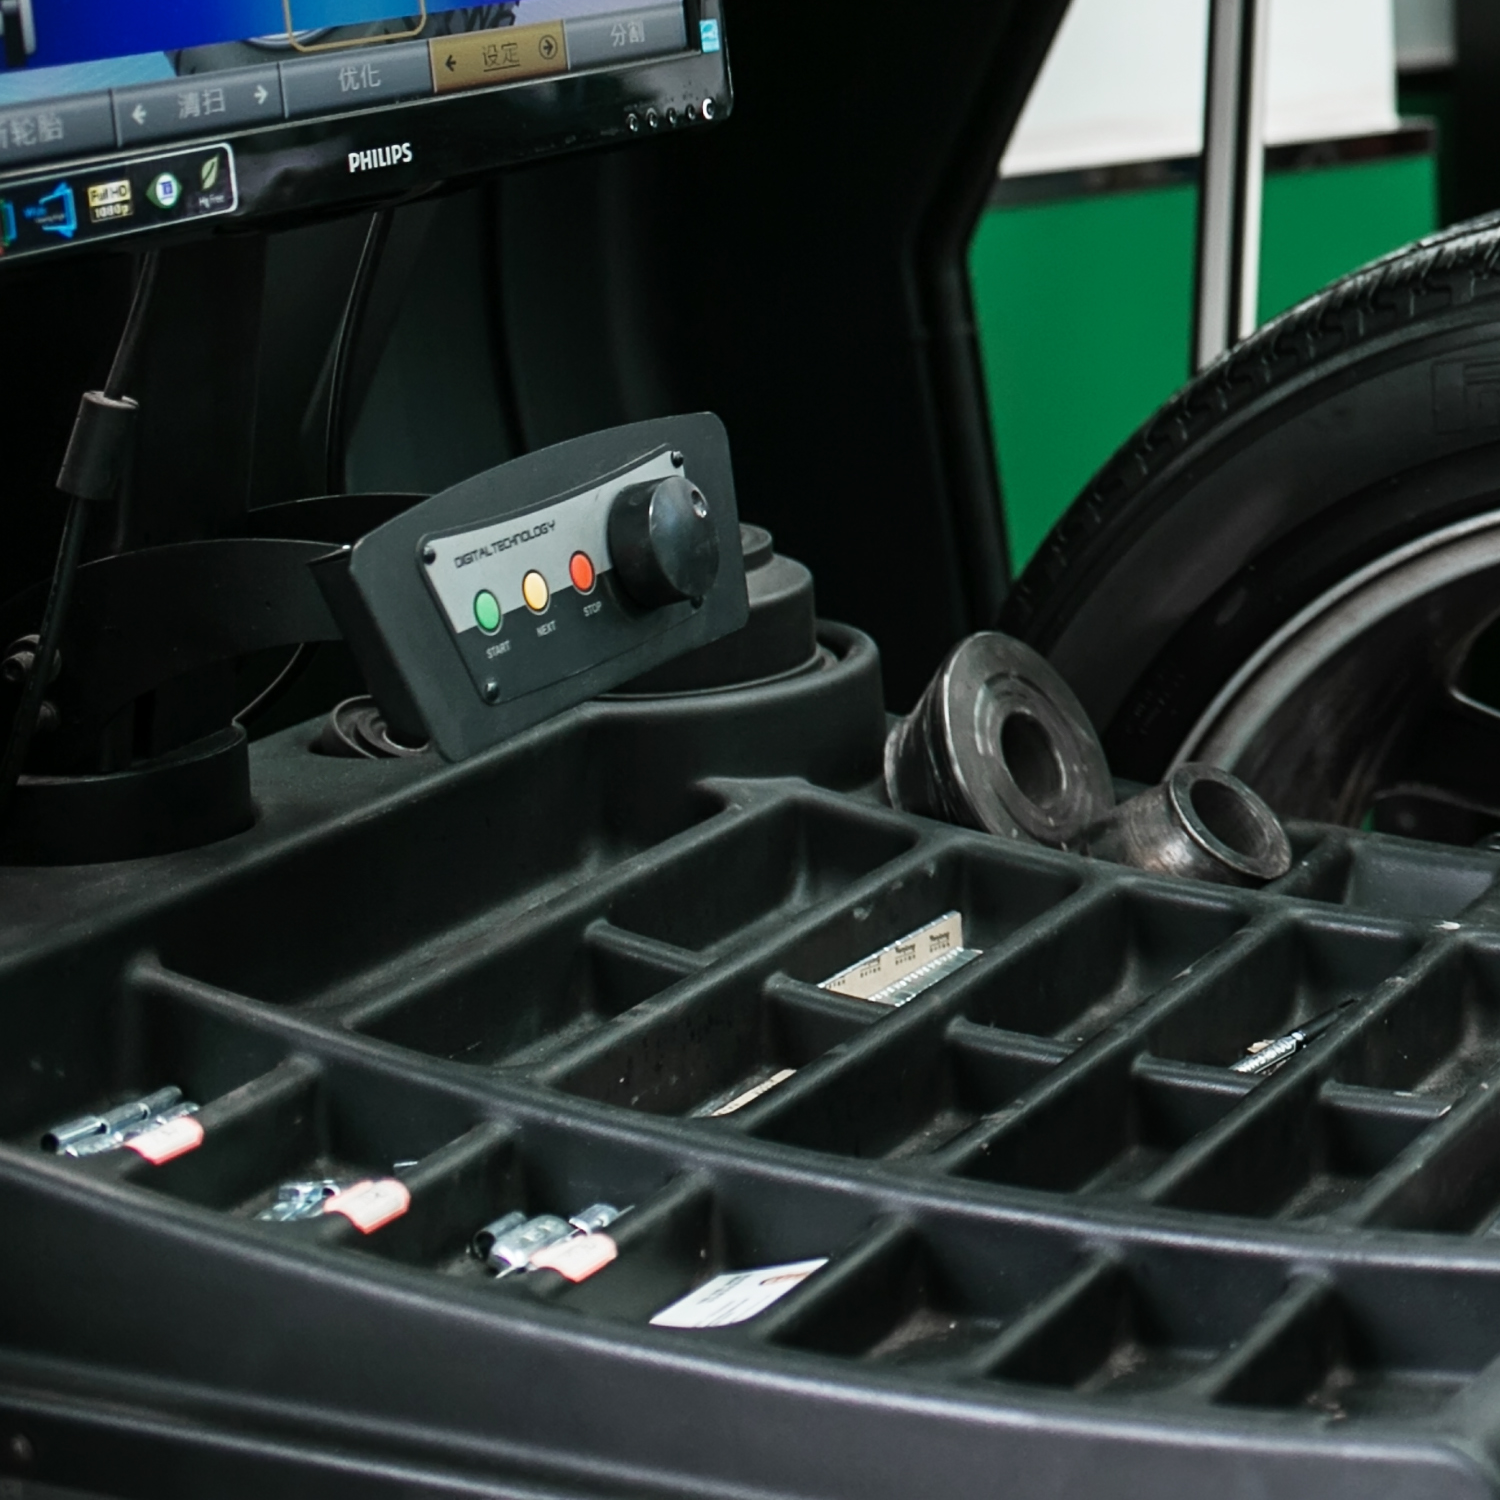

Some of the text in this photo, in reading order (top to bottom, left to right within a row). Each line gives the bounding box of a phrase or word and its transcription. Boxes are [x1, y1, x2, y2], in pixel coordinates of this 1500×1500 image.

[609, 19, 646, 48] 分割
[480, 41, 522, 68] 设定
[337, 62, 382, 93] 优化
[177, 87, 227, 120] 清扫
[347, 143, 413, 174] PHILIPS
[93, 204, 130, 220] 1080p
[583, 601, 602, 617] STOP
[536, 619, 557, 638] NEXT
[486, 639, 512, 659] START
